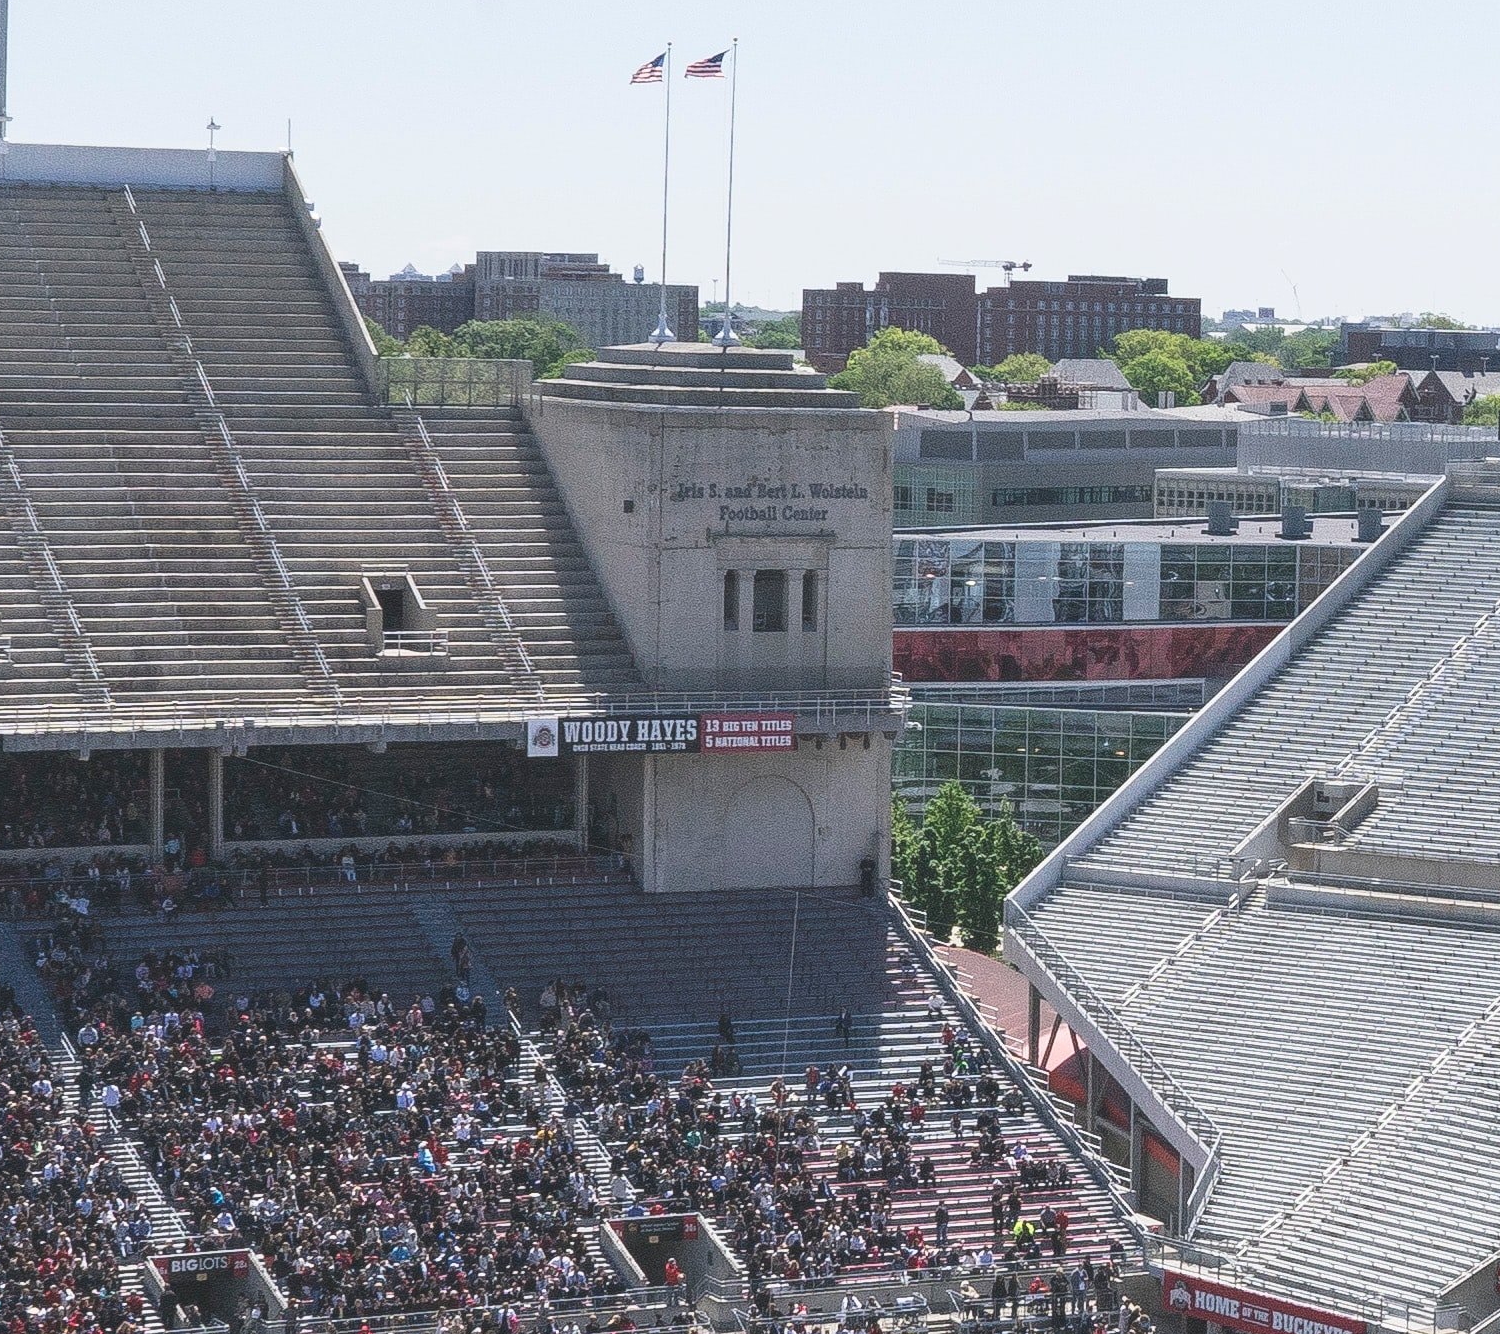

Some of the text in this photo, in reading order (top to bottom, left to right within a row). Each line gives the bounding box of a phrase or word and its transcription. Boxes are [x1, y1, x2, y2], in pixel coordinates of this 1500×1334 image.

[725, 484, 750, 499] and
[757, 483, 787, 499] Bert
[720, 506, 828, 521] Football Center
[563, 720, 697, 743] WOODY HAYES
[705, 720, 792, 732] 13 BIG TEN TITLES
[705, 735, 792, 748] 5 NATIONAL TITLES
[171, 1259, 198, 1273] BIG
[1194, 1289, 1240, 1318] HOME
[1254, 1310, 1269, 1323] THE
